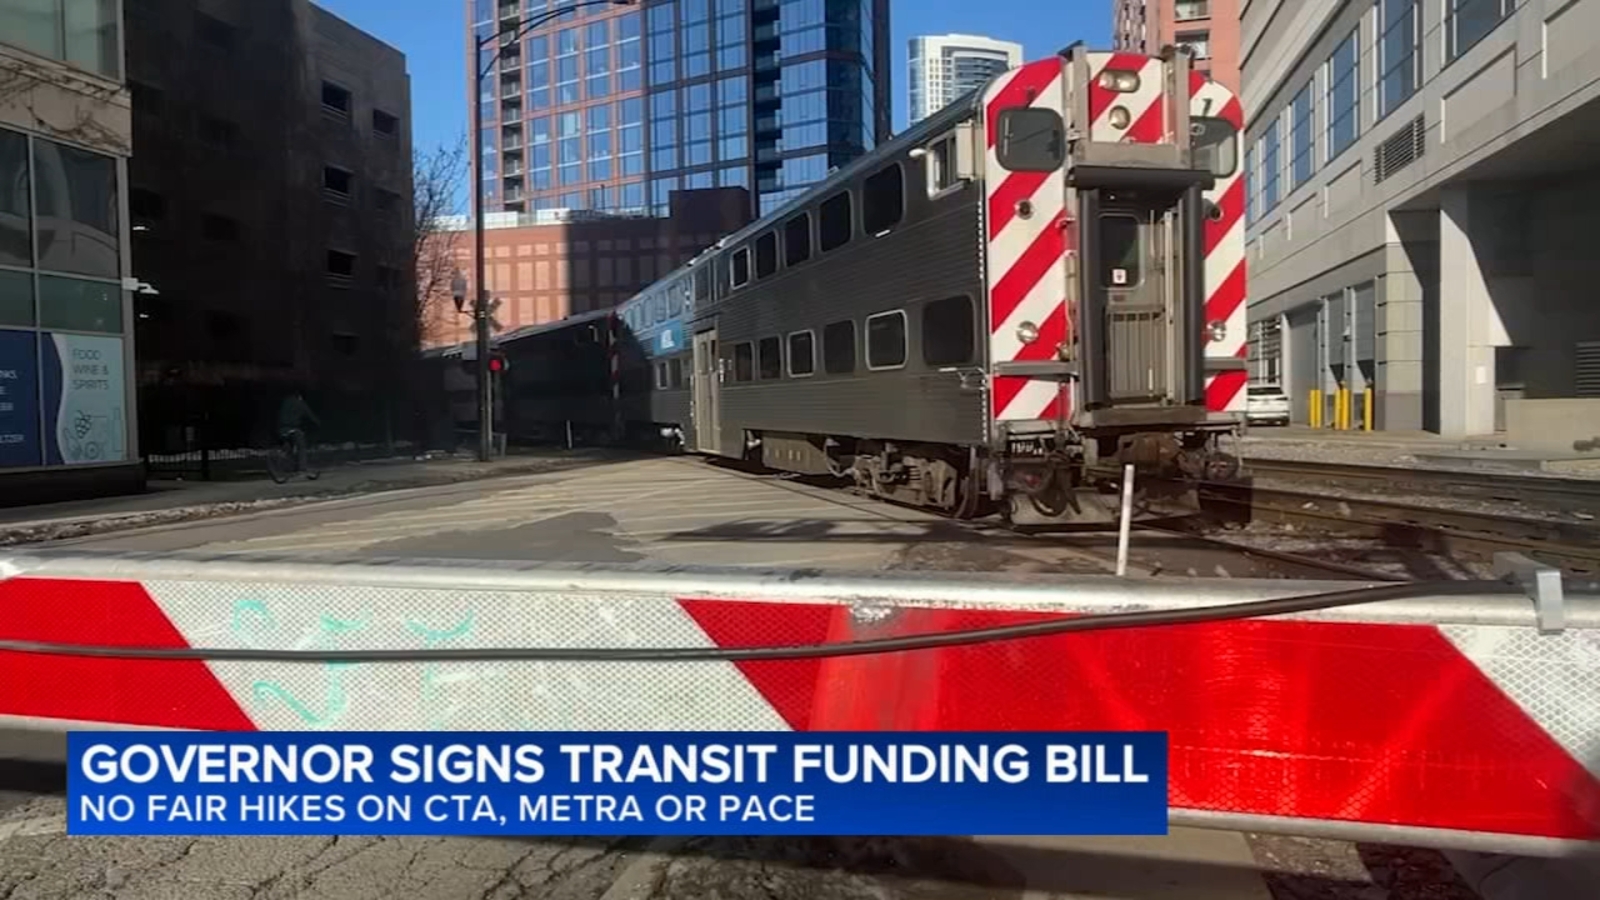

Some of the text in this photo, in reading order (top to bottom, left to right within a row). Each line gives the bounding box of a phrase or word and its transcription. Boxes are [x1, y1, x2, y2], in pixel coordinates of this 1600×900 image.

[72, 348, 102, 360] FOOD
[72, 364, 109, 375] WINE &
[72, 379, 110, 390] SPIRITS
